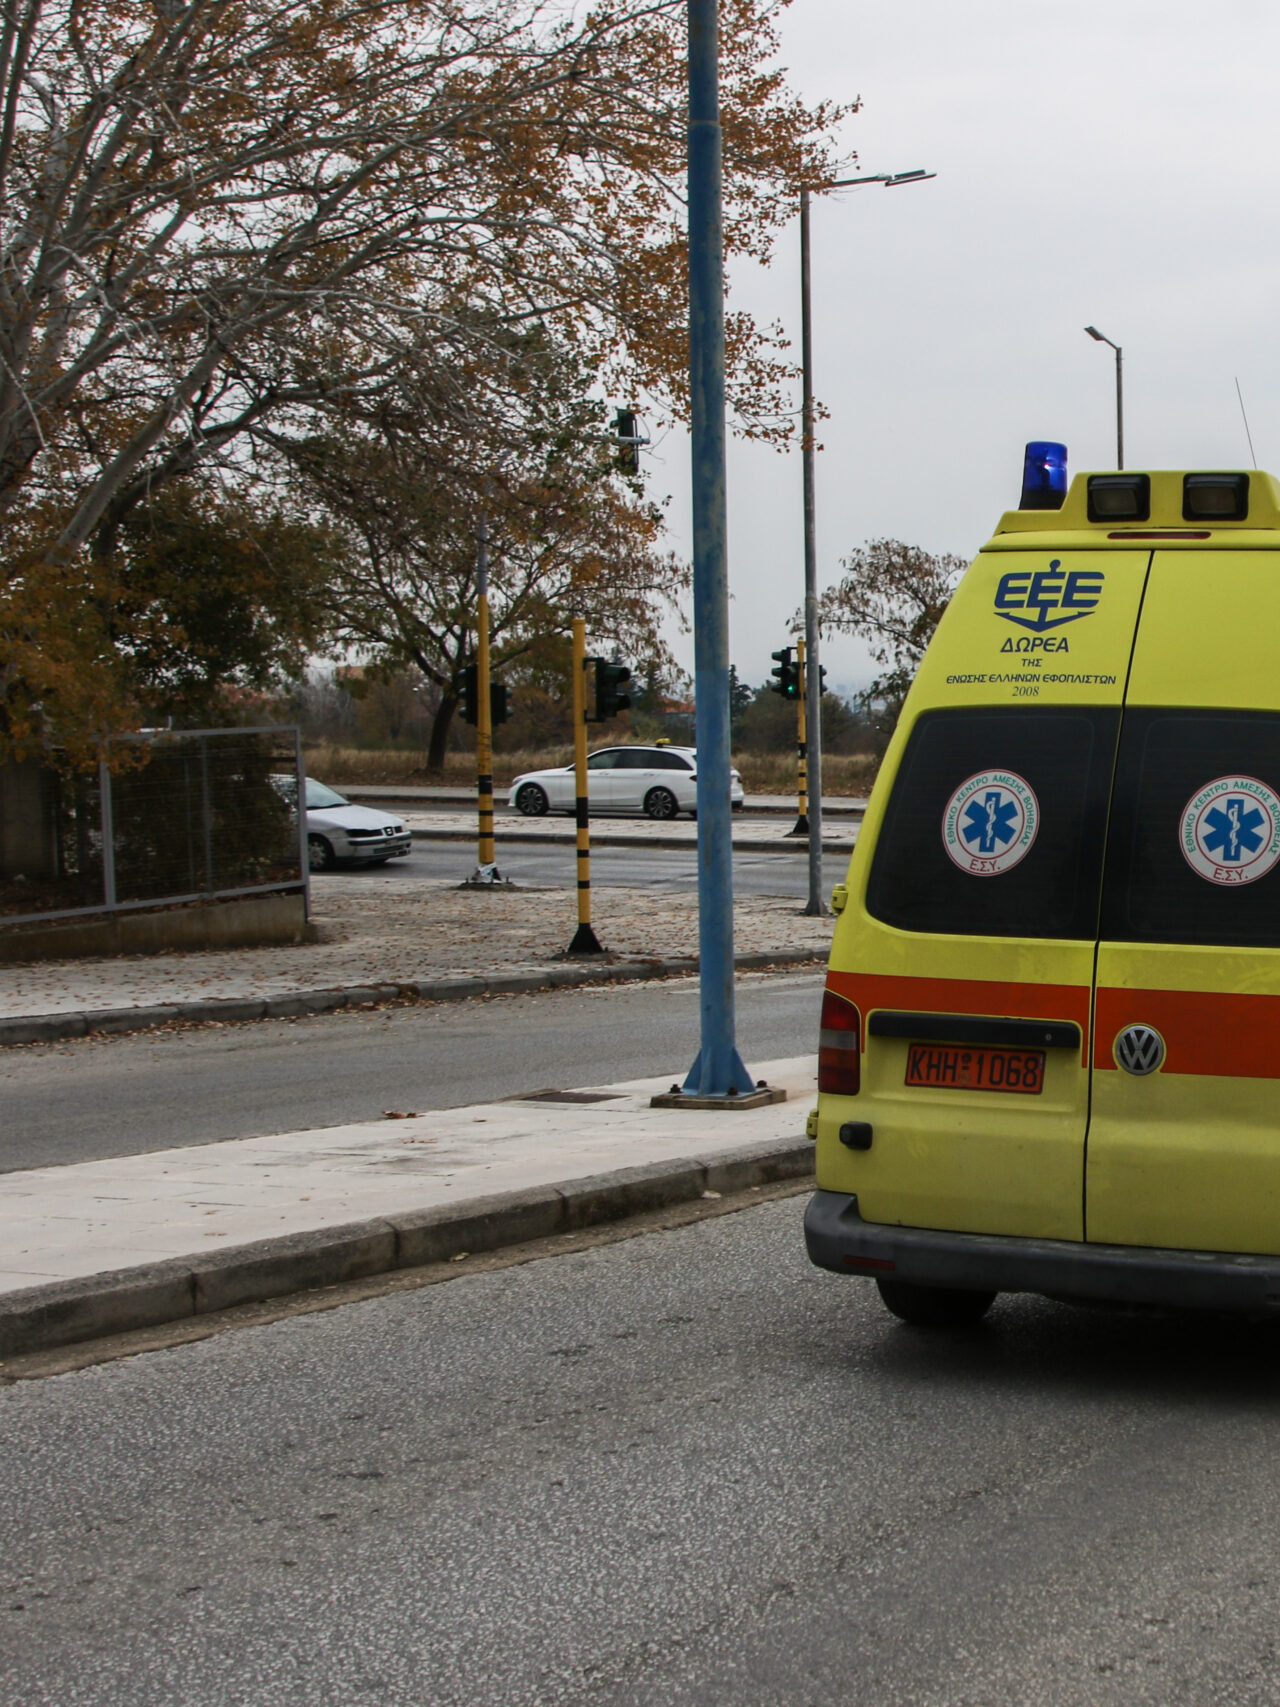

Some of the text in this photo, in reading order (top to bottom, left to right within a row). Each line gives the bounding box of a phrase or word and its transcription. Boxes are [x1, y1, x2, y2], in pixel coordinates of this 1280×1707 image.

[1000, 637, 1069, 653] ΔΩΡΕΑ
[1021, 658, 1043, 668] ΤΗΣ
[946, 673, 1116, 685] ΕΝΩΣΗΣ ΕΛΛΗΝΩΝ ΕΦΟΠΛΙΣΤΩΝ
[1012, 686, 1039, 697] 2008
[946, 774, 1035, 847] ΕΘΝΙΚΟ ΚΕΝΤΡΟ ΑΜΕΣΗΣ ΒΟΗΘΕΙΑΣ
[1184, 813, 1196, 853] ΕΘΝΙΚΟ
[1193, 782, 1228, 810] ΚΕΝΤΡΟ
[1233, 781, 1271, 803] ΑΜΕΣΗΣ
[1213, 867, 1248, 881] Ε.Σ.Υ.
